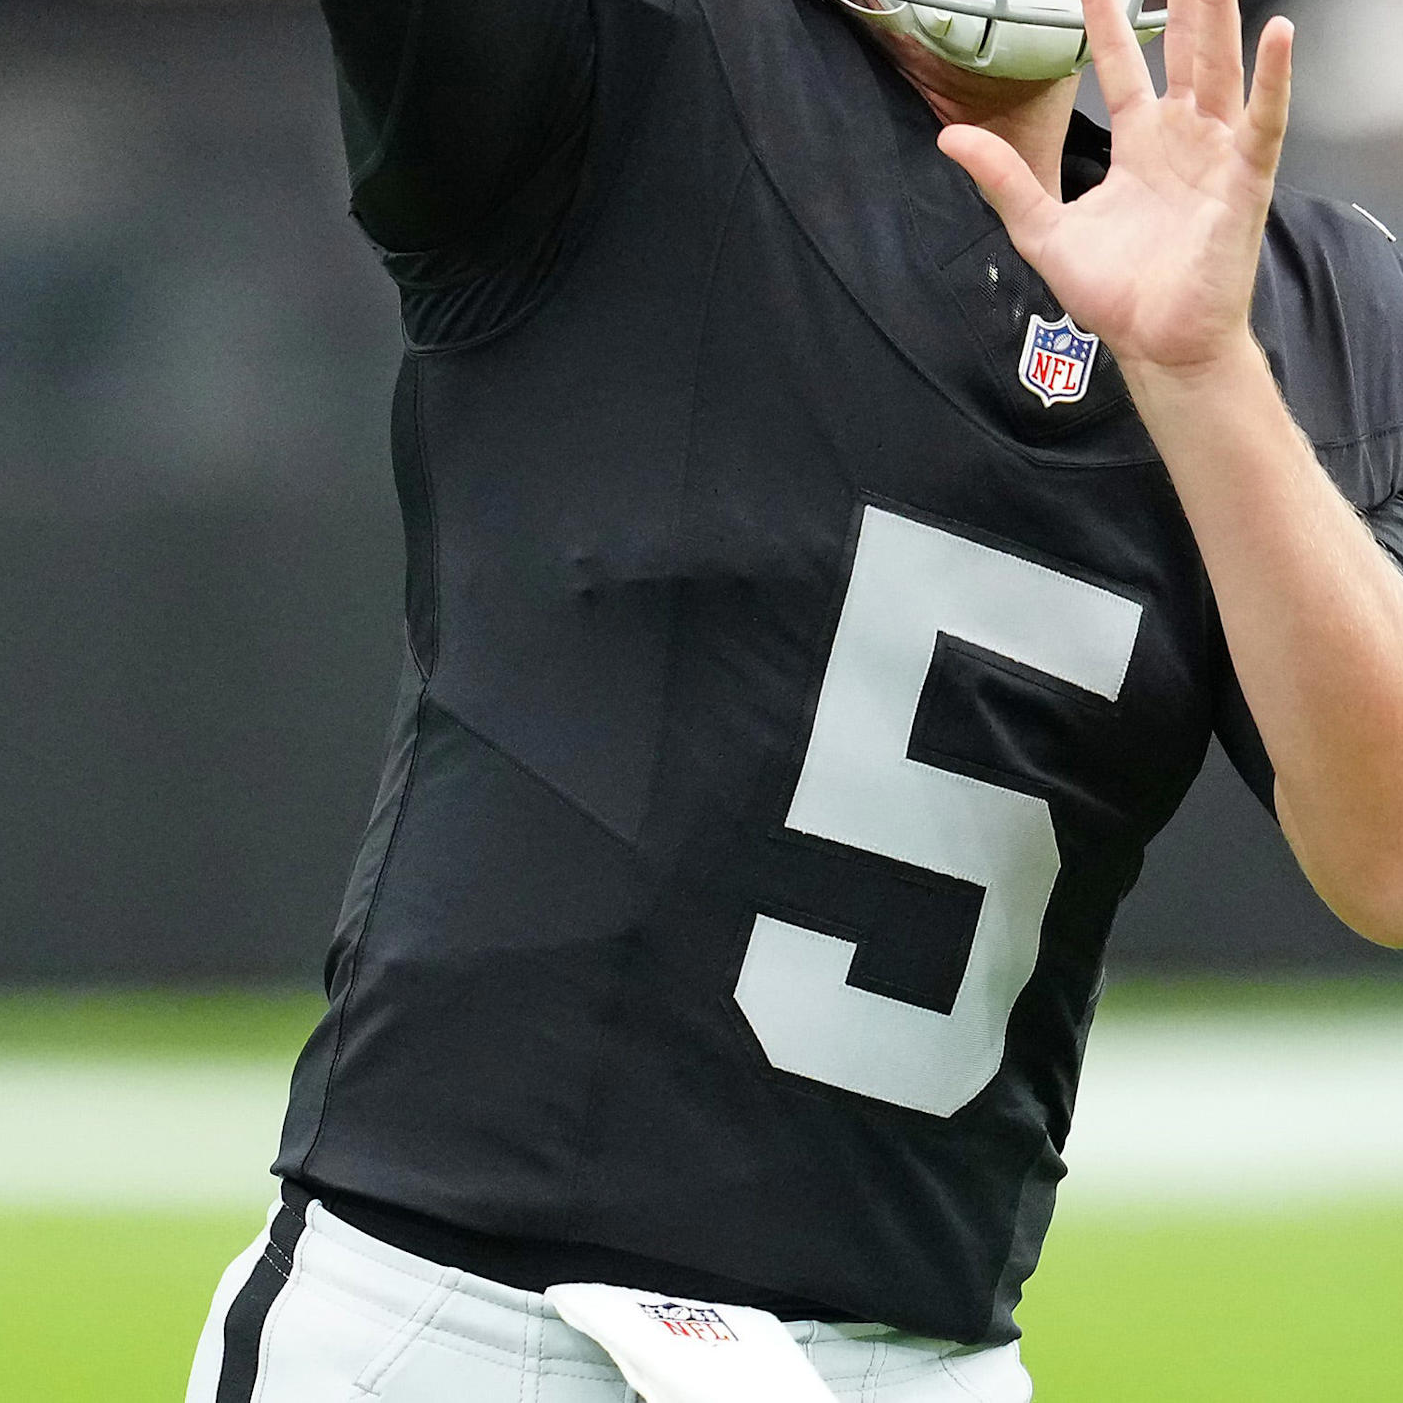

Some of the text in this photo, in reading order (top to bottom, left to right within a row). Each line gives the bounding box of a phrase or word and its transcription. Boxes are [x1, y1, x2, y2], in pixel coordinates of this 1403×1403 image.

[1031, 351, 1076, 391] NFL
[733, 504, 1143, 1119] 5
[659, 1320, 729, 1341] NFL
